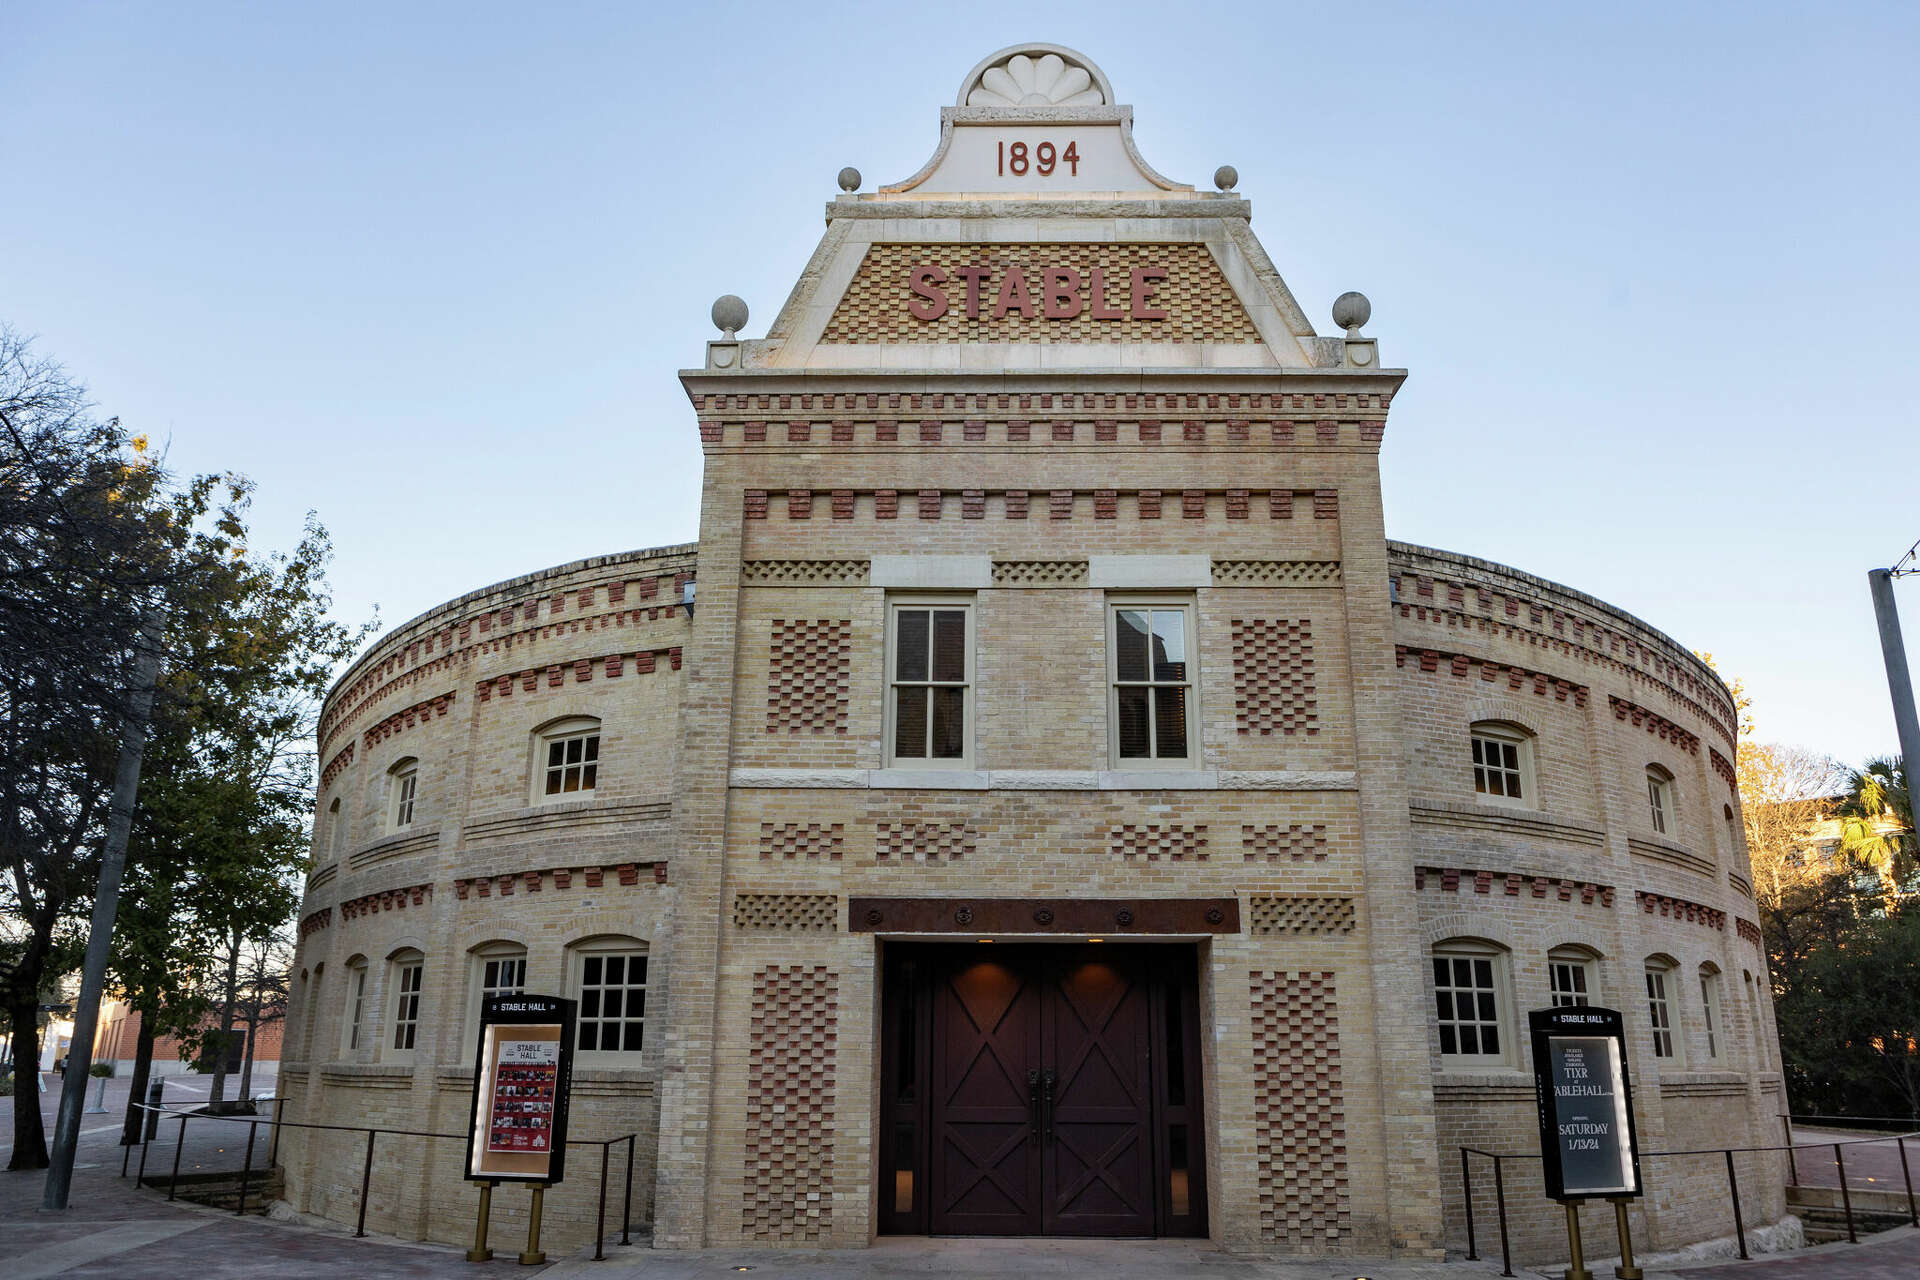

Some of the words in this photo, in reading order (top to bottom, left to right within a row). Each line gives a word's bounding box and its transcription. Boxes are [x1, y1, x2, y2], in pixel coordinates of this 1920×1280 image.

[997, 140, 1080, 177] 1894
[908, 266, 1168, 321] STABLE
[500, 1003, 526, 1011] STABLE
[528, 1003, 546, 1011] HALL
[1560, 1014, 1585, 1023] STABLE
[1587, 1015, 1604, 1024] HALL
[516, 1044, 541, 1052] STABLE
[520, 1052, 538, 1060] HALL
[1563, 1067, 1588, 1079] TIXR
[1559, 1123, 1609, 1136] SATURDAY
[1568, 1139, 1600, 1151] 1/13/24
